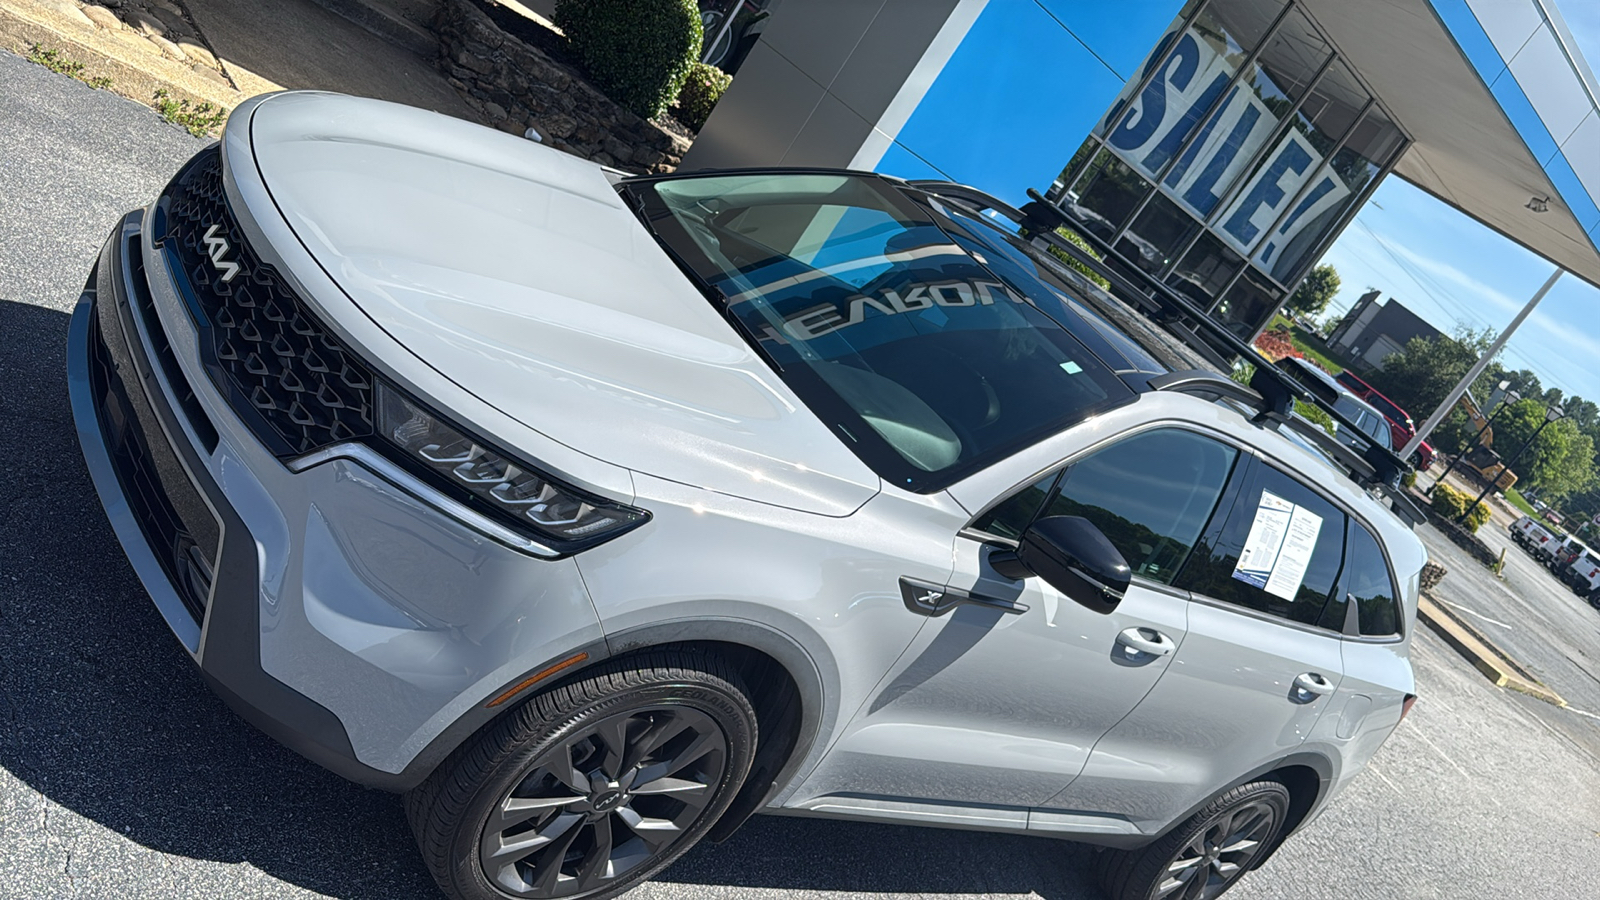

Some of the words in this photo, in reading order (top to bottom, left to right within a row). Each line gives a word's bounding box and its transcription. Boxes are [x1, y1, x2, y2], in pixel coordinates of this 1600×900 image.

[1104, 29, 1337, 265] SALE!
[203, 224, 240, 281] KIA
[669, 689, 745, 728] GEOLANDAR
